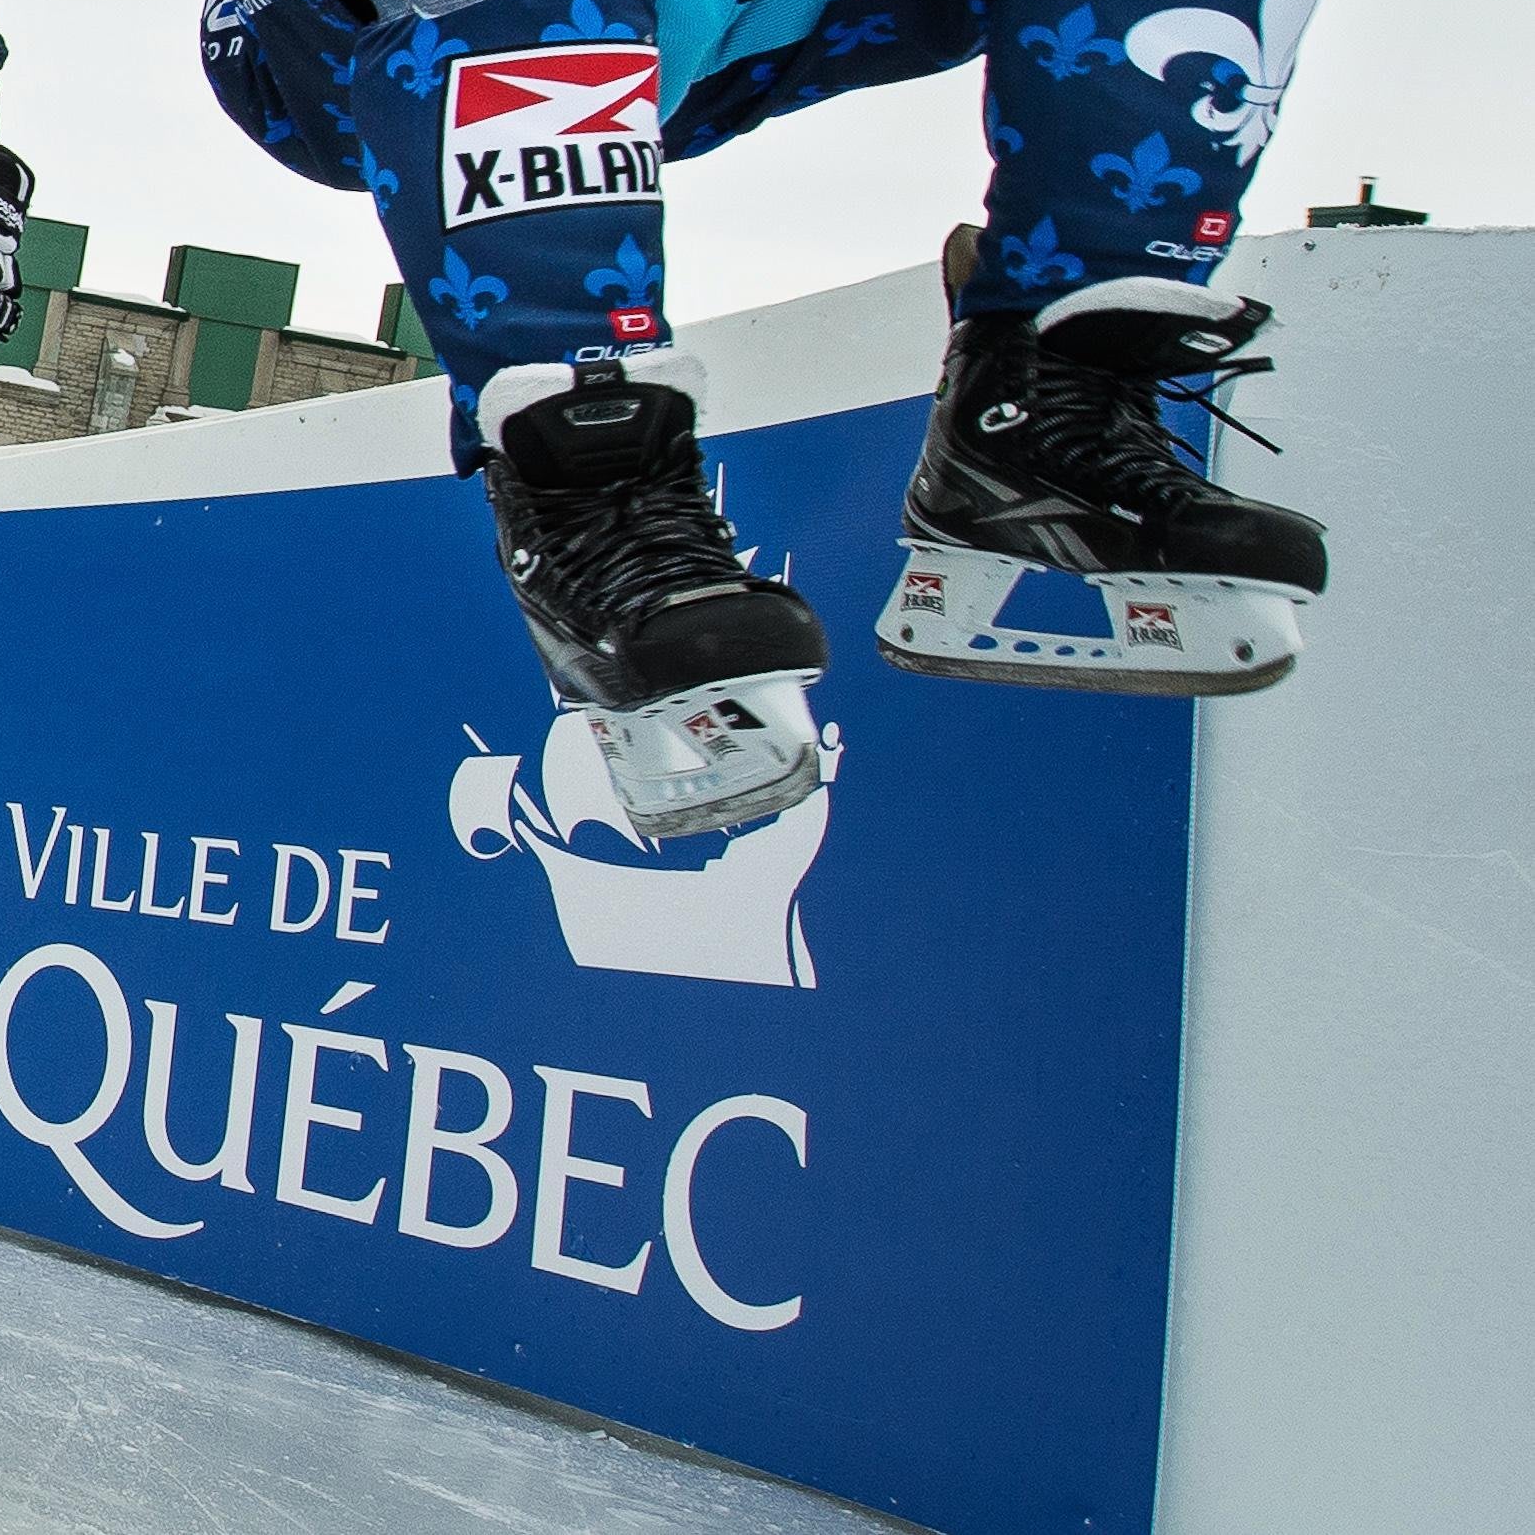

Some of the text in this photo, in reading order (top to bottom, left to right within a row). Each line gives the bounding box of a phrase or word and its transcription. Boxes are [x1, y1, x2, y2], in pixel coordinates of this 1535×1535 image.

[454, 140, 664, 216] X-BLAD
[6, 801, 392, 945] VILLE DE
